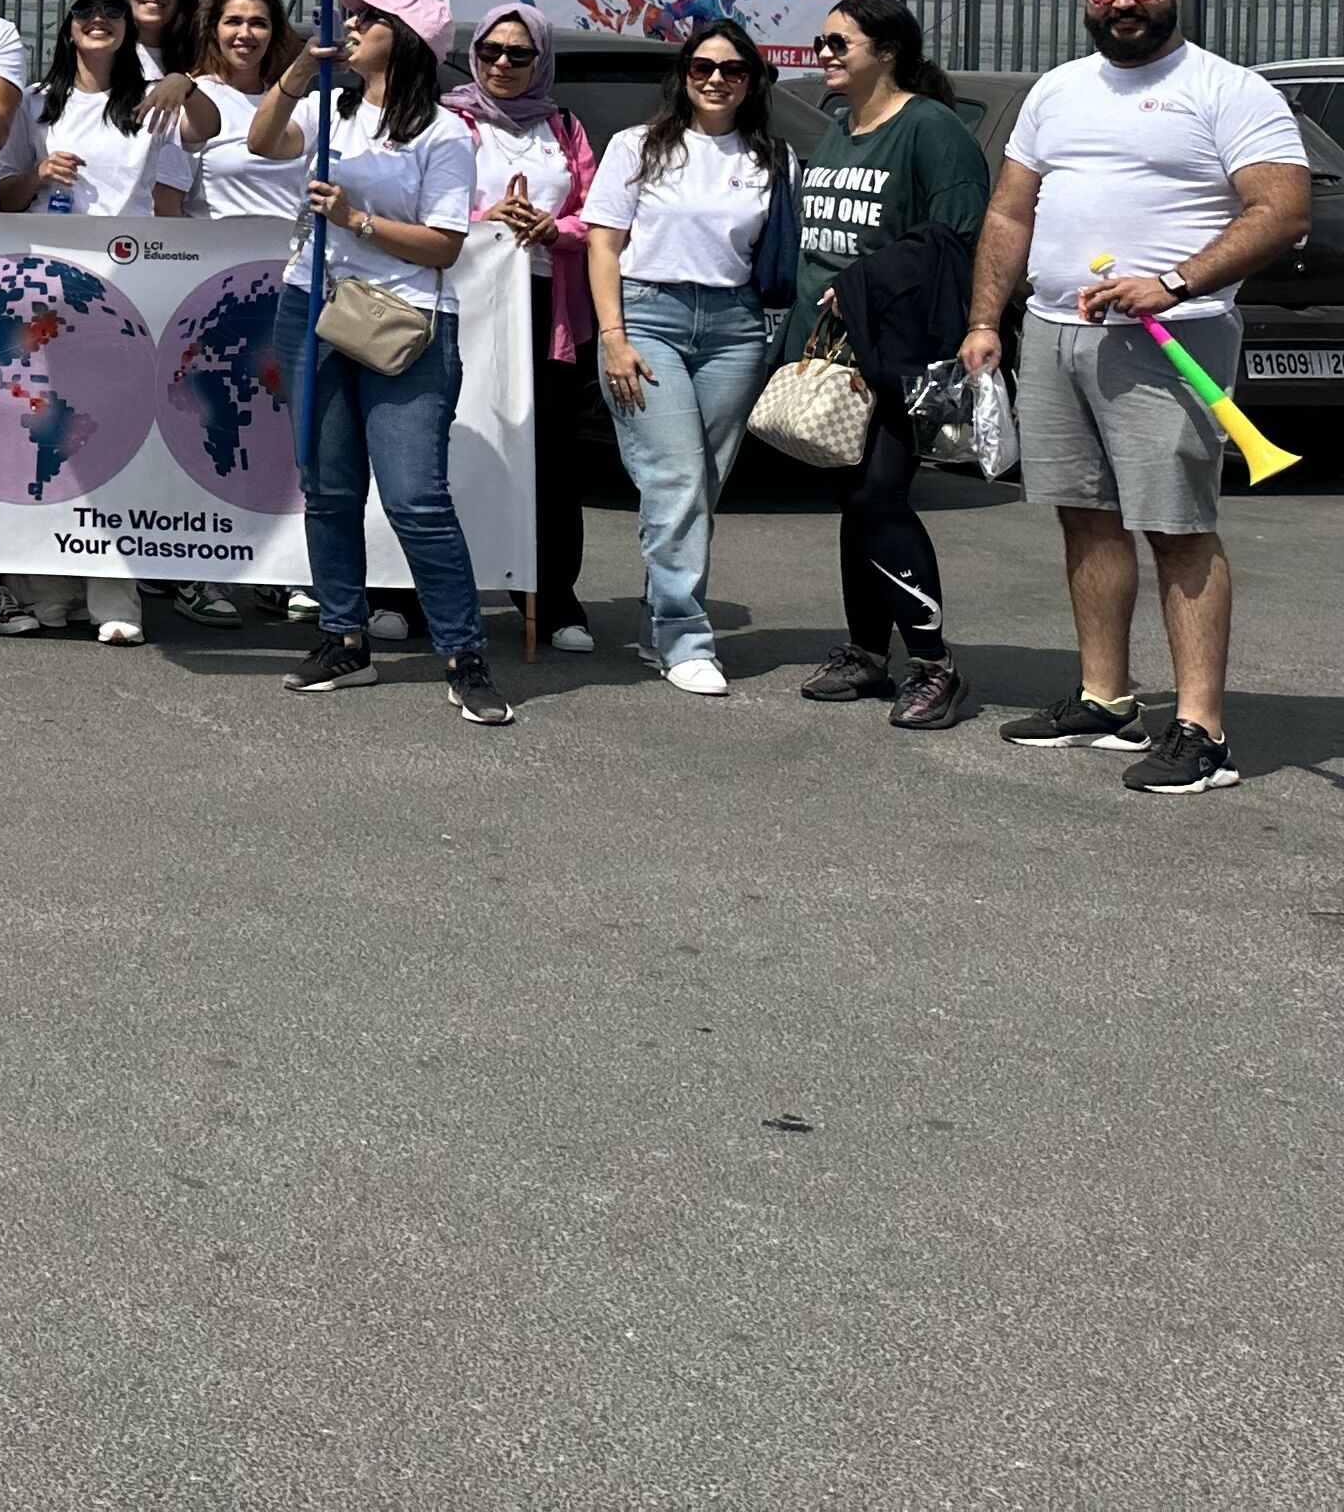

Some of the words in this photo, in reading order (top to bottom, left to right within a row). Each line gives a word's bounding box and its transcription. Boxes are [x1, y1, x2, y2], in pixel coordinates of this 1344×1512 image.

[833, 167, 890, 194] ONLY
[837, 197, 883, 227] ONE
[144, 241, 163, 250] LCI
[144, 250, 199, 261] Education
[1252, 353, 1309, 375] 81609
[73, 507, 122, 529] The
[128, 509, 206, 532] World
[213, 512, 233, 533] is
[54, 533, 111, 555] Your
[116, 535, 254, 561] Classroom
